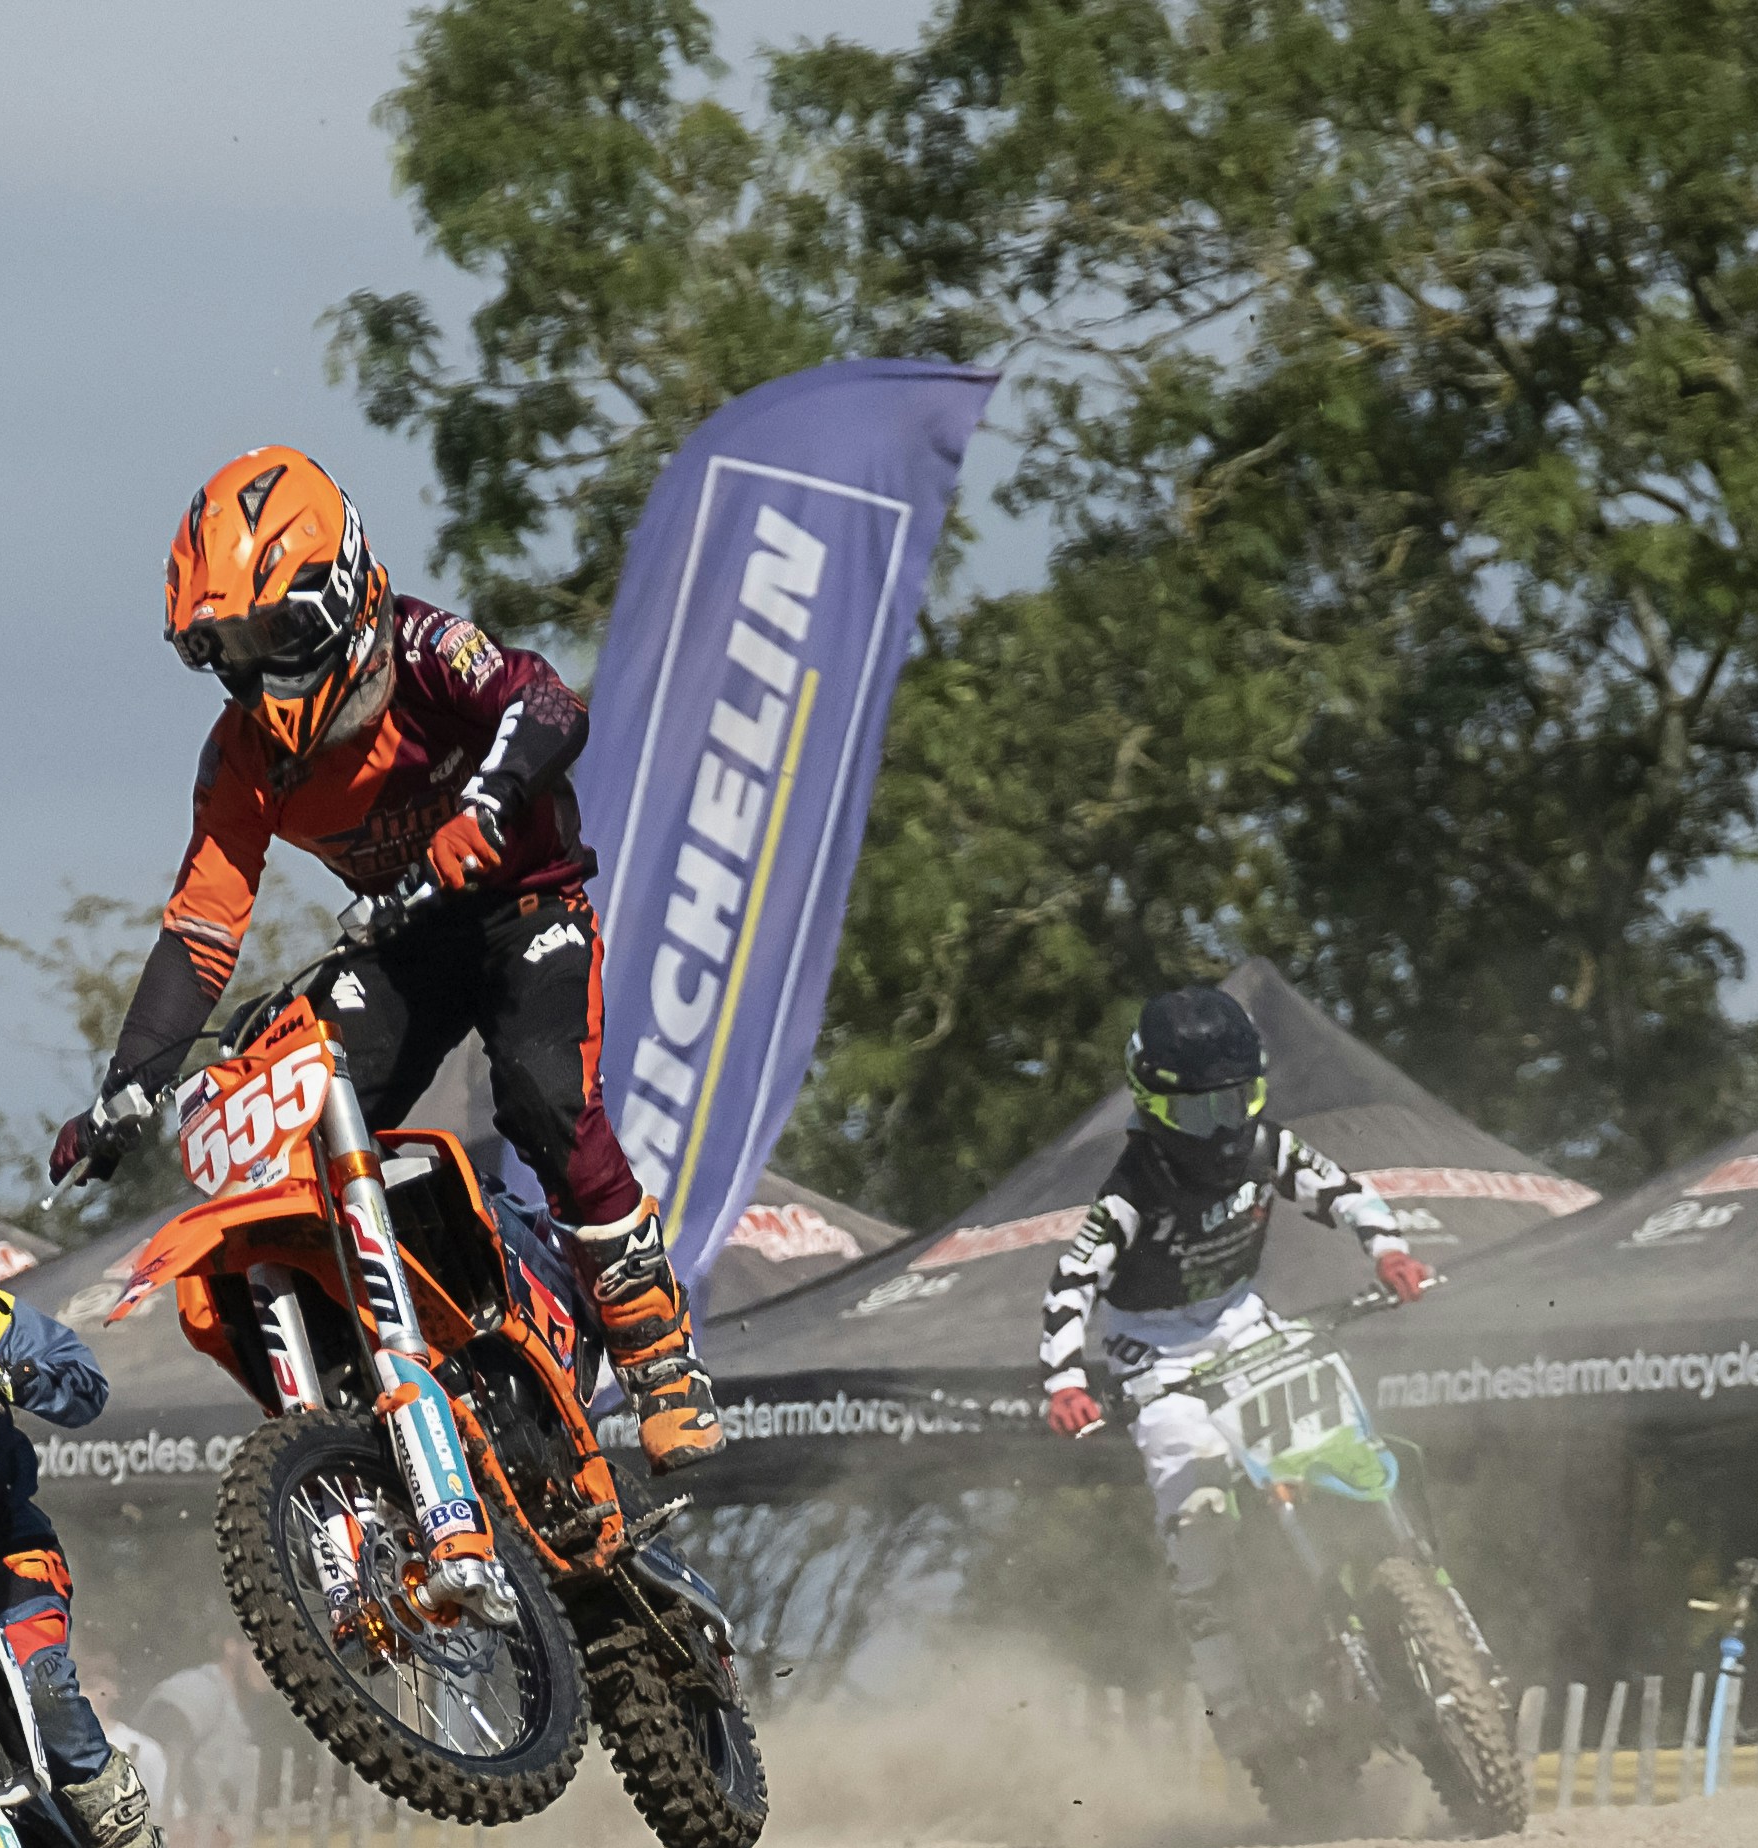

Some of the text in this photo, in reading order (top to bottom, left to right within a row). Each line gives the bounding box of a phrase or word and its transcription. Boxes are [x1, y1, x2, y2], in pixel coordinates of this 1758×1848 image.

[617, 504, 828, 1200] MICHELIN
[265, 1015, 304, 1050] KTM
[186, 1041, 328, 1196] 555
